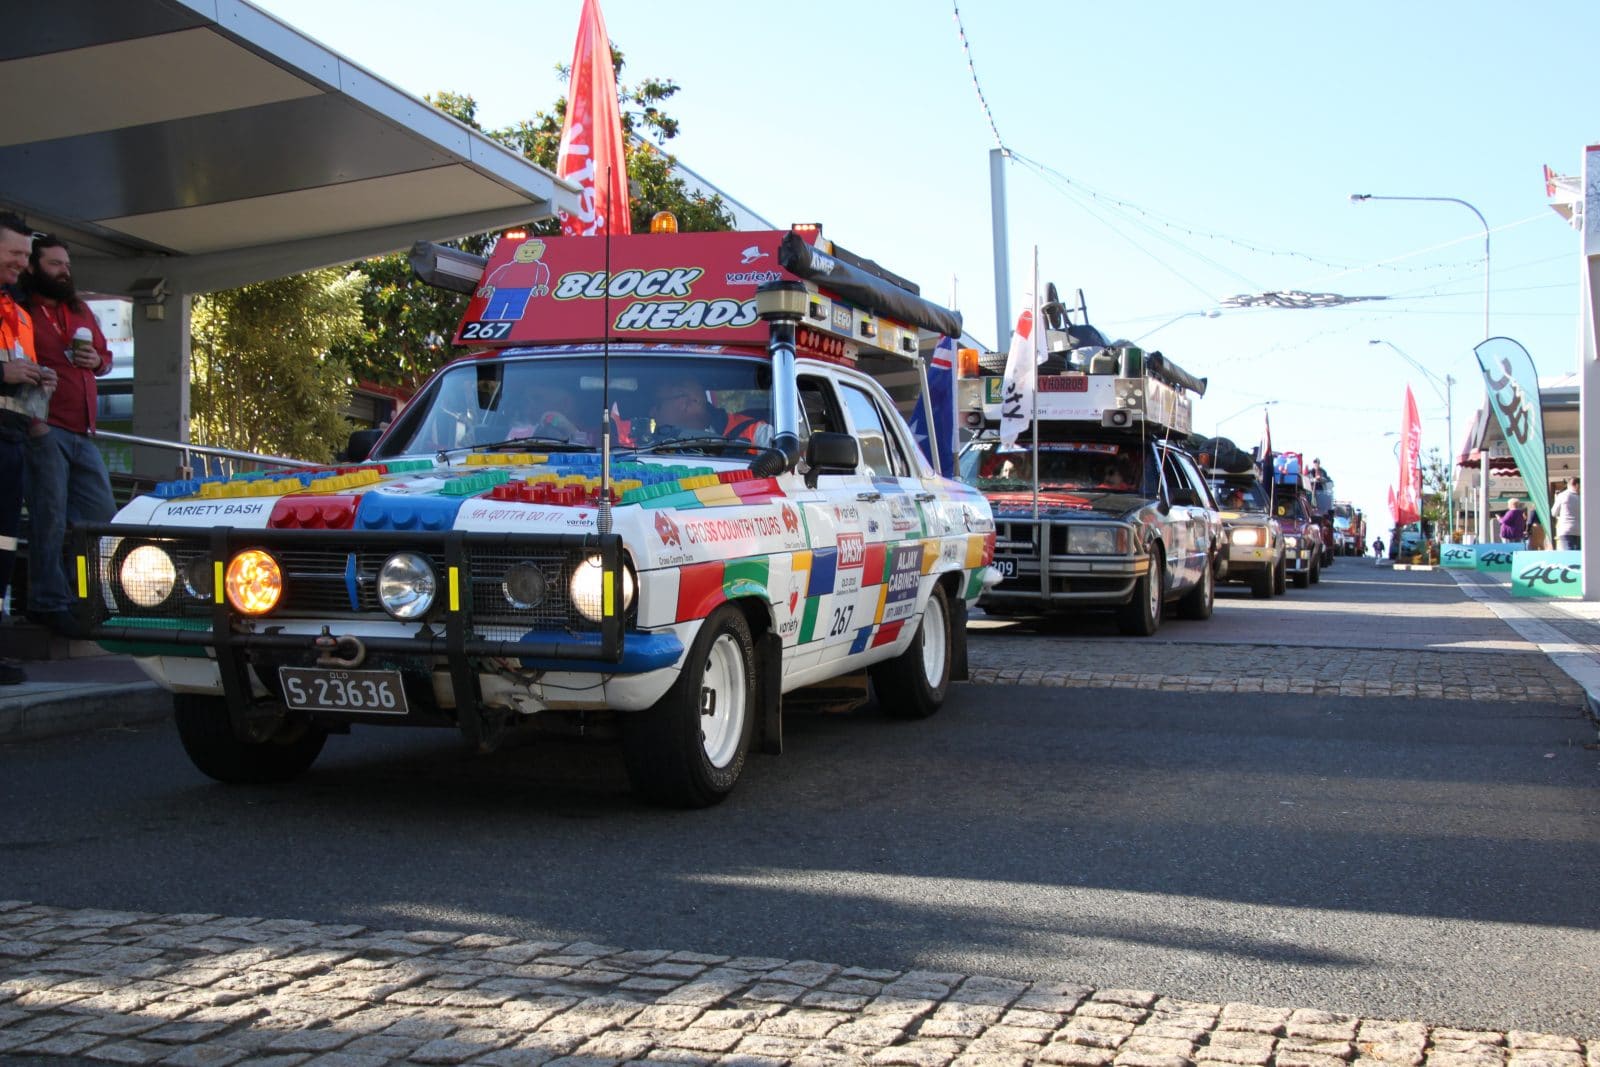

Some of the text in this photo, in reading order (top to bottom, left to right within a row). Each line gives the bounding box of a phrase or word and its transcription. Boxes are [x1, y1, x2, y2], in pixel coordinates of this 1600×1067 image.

[552, 267, 704, 299] BLOCK
[726, 271, 782, 283] variety
[613, 298, 762, 331] HEADS
[832, 307, 851, 328] LEGO
[462, 322, 512, 339] 267
[167, 504, 263, 516] VARIETY BASH
[566, 519, 595, 527] variety
[685, 516, 781, 544] CROSS COUNTRY TOURS
[841, 538, 863, 564] BASH
[897, 551, 919, 570] ALJAY
[1444, 549, 1474, 560] 4CC
[889, 570, 920, 592] CABINETS
[1519, 564, 1582, 588] 4CC
[780, 616, 799, 634] variety
[830, 604, 854, 636] 267
[329, 671, 349, 680] QLD
